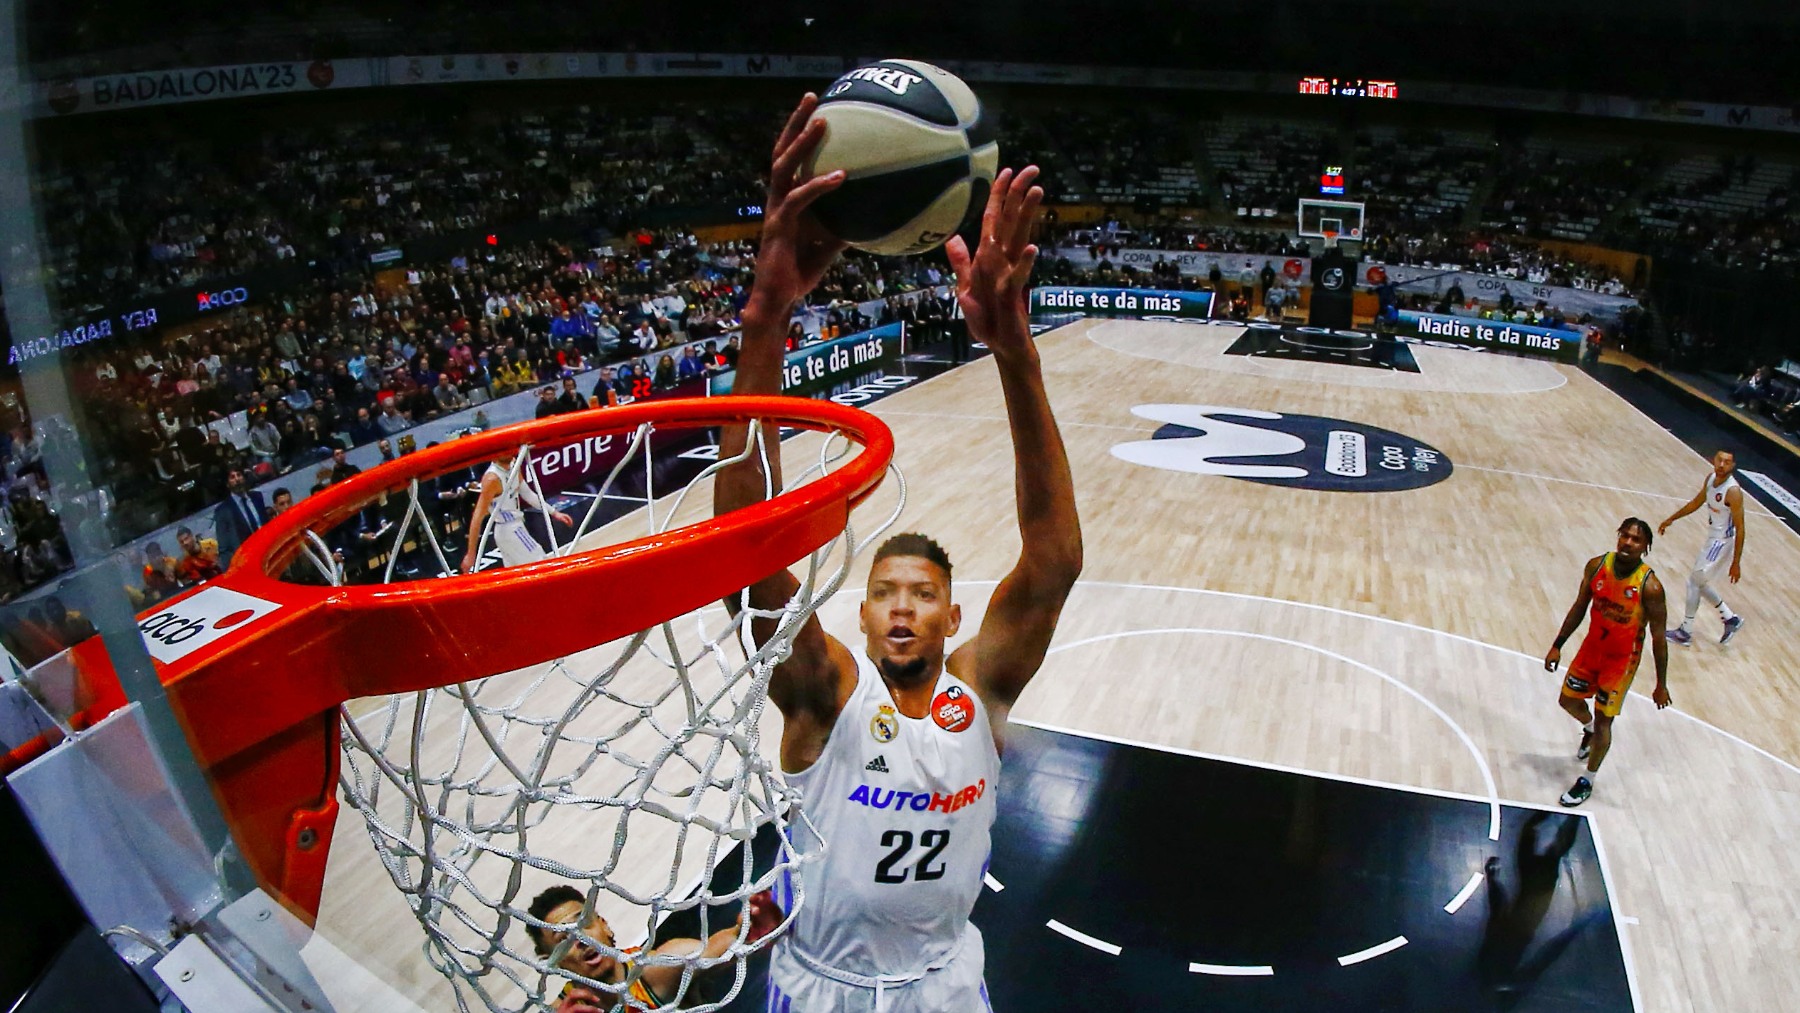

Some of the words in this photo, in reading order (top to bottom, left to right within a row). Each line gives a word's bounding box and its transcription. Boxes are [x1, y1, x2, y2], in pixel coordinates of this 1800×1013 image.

[93, 64, 297, 105] BADALONA'23
[1090, 292, 1109, 309] te
[1114, 291, 1138, 310] da
[1143, 293, 1181, 312] más
[1532, 286, 1552, 298] REY
[1418, 316, 1470, 339] Nadie
[1476, 324, 1494, 341] te
[1499, 326, 1520, 345] da
[1526, 332, 1561, 351] más
[806, 355, 825, 381] te
[829, 344, 850, 373] da
[853, 333, 883, 365] más
[1379, 445, 1408, 471] Copa
[1412, 446, 1439, 464] Rey
[139, 612, 207, 645] acb
[874, 829, 950, 884] 22
